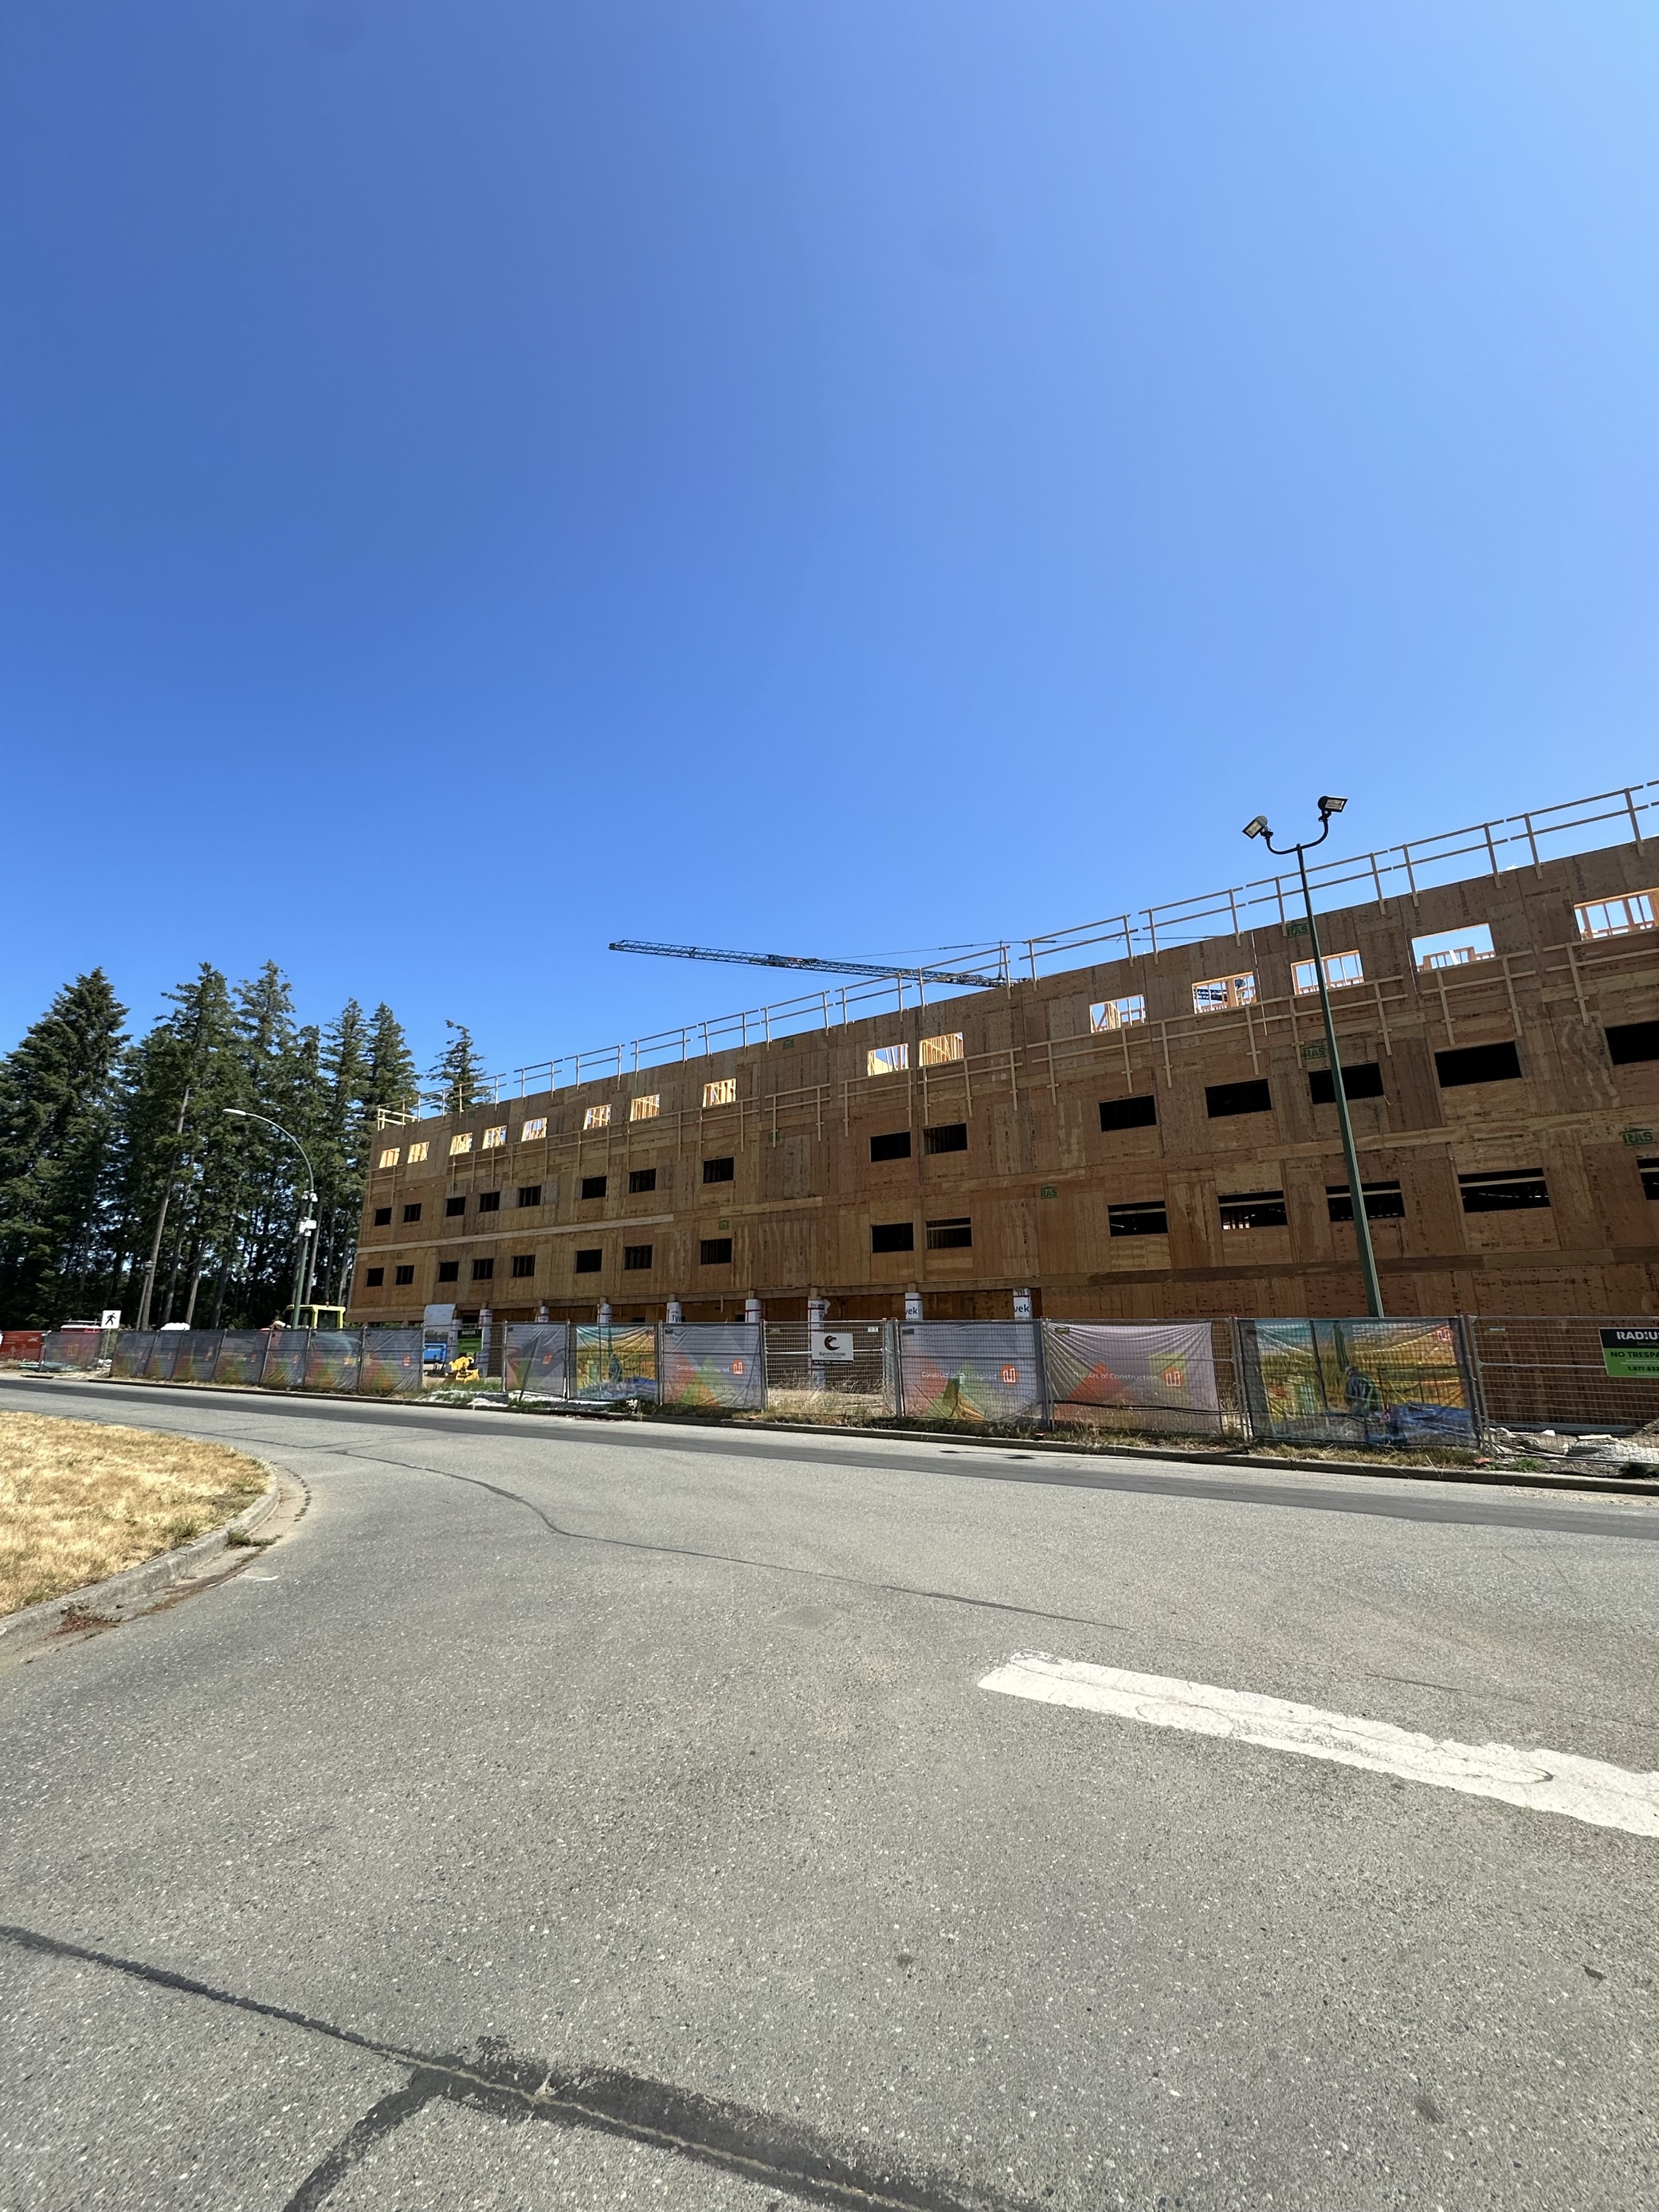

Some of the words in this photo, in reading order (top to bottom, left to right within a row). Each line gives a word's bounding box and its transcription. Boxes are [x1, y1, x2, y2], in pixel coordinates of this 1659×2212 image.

[1303, 1047, 1326, 1057] RAS
[1041, 1189, 1057, 1198] RAS
[1616, 1331, 1659, 1340] RADIU
